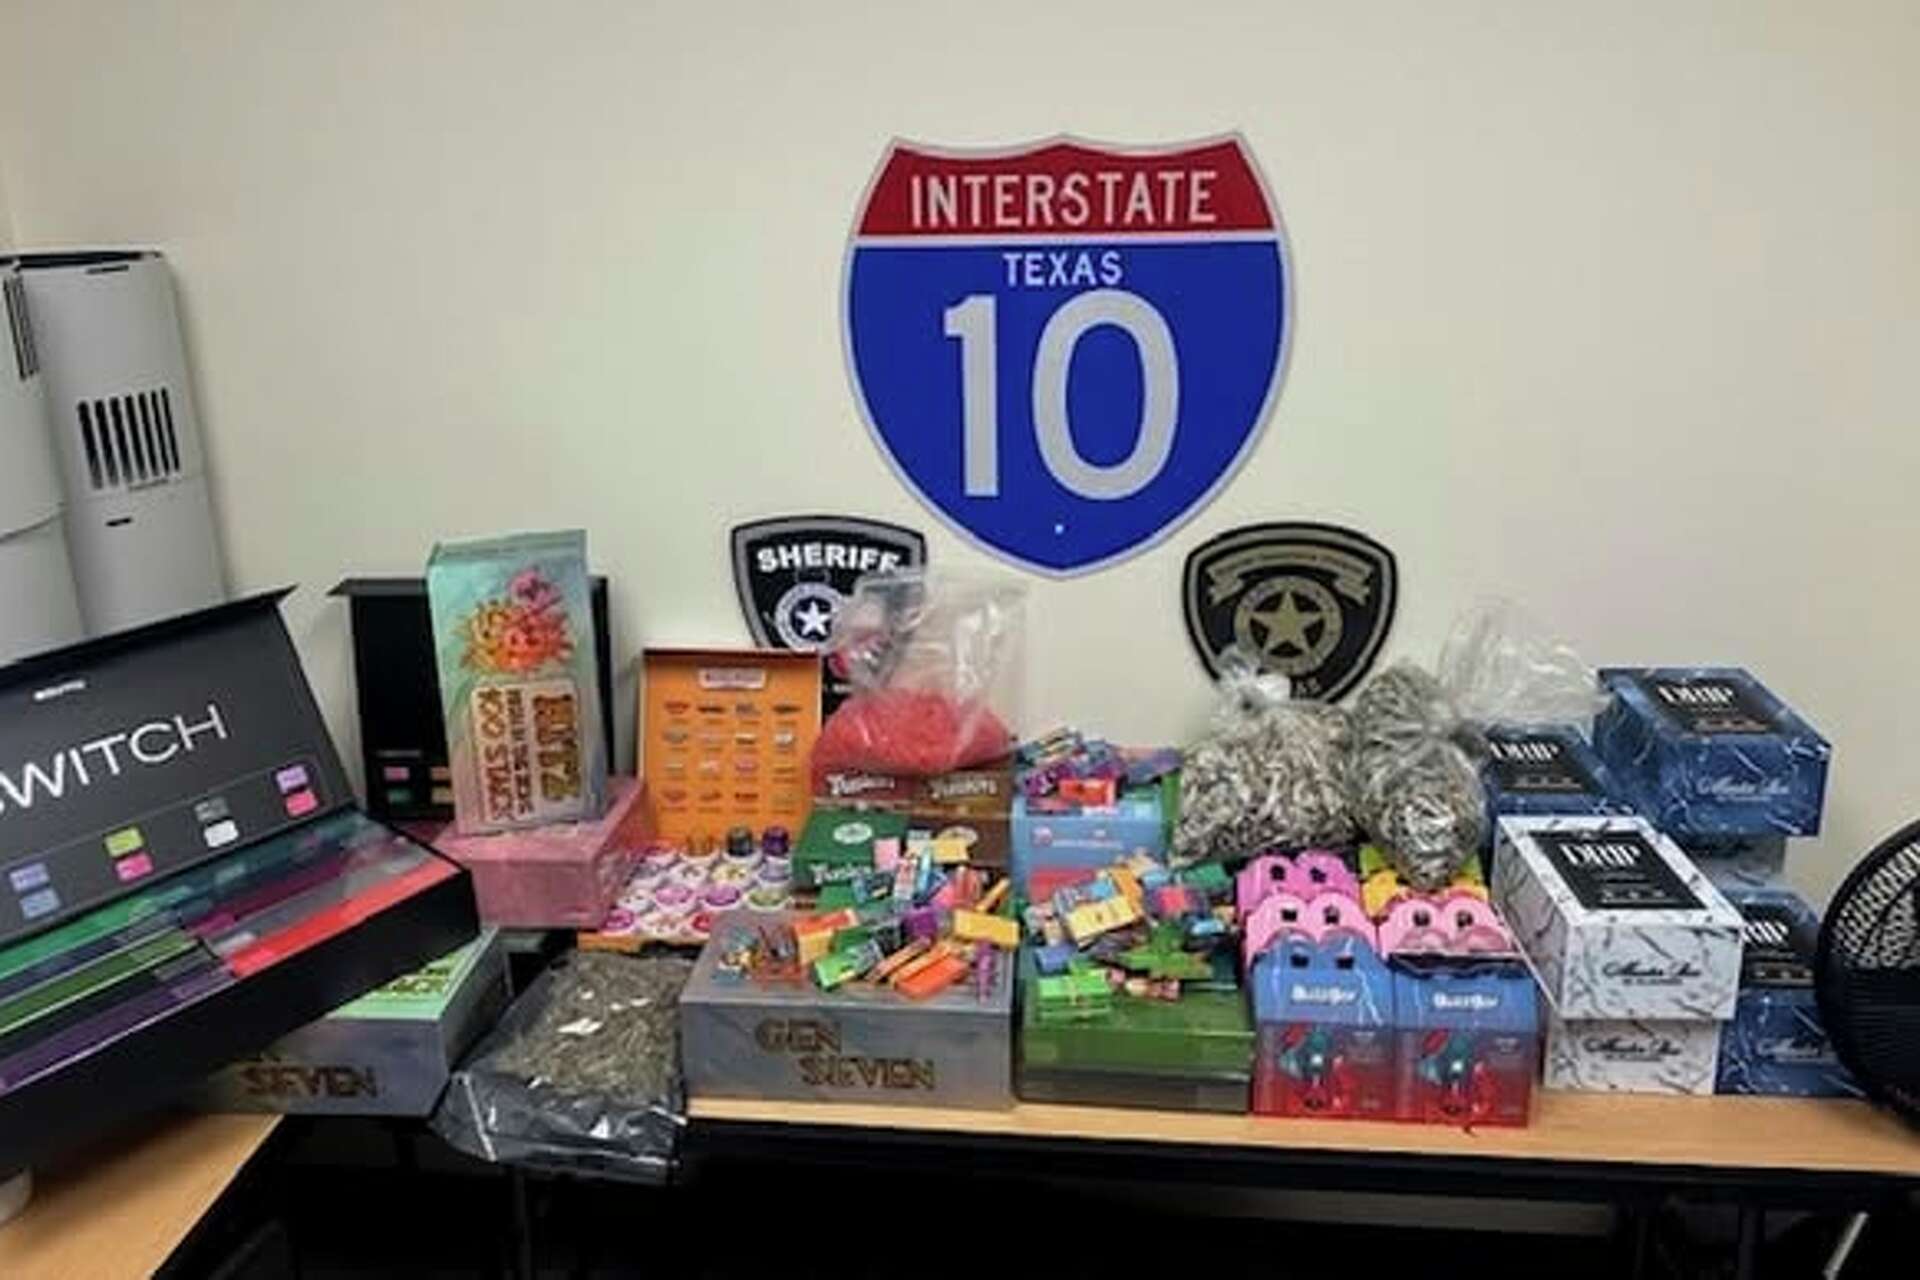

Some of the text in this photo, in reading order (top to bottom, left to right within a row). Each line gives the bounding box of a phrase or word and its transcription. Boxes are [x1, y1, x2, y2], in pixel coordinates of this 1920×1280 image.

[911, 171, 1217, 229] INTERSTATE
[1004, 252, 1123, 286] TEXAS
[943, 289, 1179, 500] 10
[757, 542, 900, 572] SHERIFF
[0, 703, 227, 813] WITCH
[755, 1018, 841, 1052] GEN
